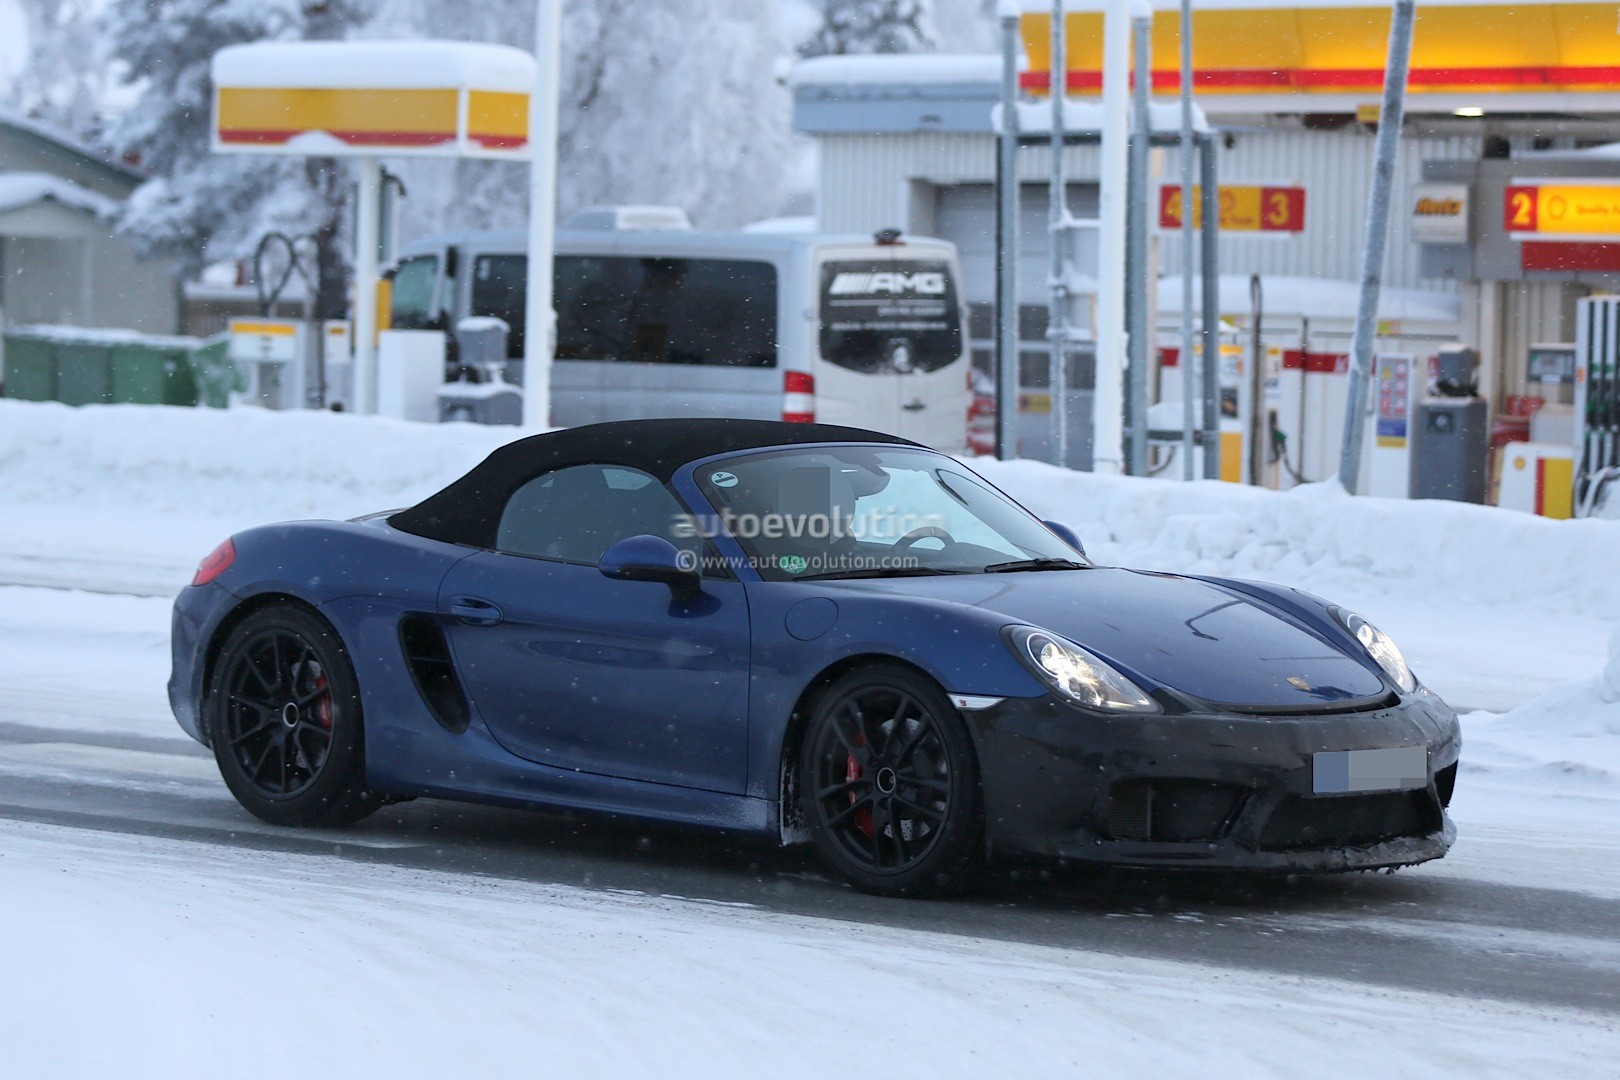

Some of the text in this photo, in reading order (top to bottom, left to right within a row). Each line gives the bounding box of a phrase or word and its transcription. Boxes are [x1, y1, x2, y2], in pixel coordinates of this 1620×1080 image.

[1269, 192, 1290, 225] 3
[1511, 192, 1532, 225] 2
[867, 273, 945, 294] AMG
